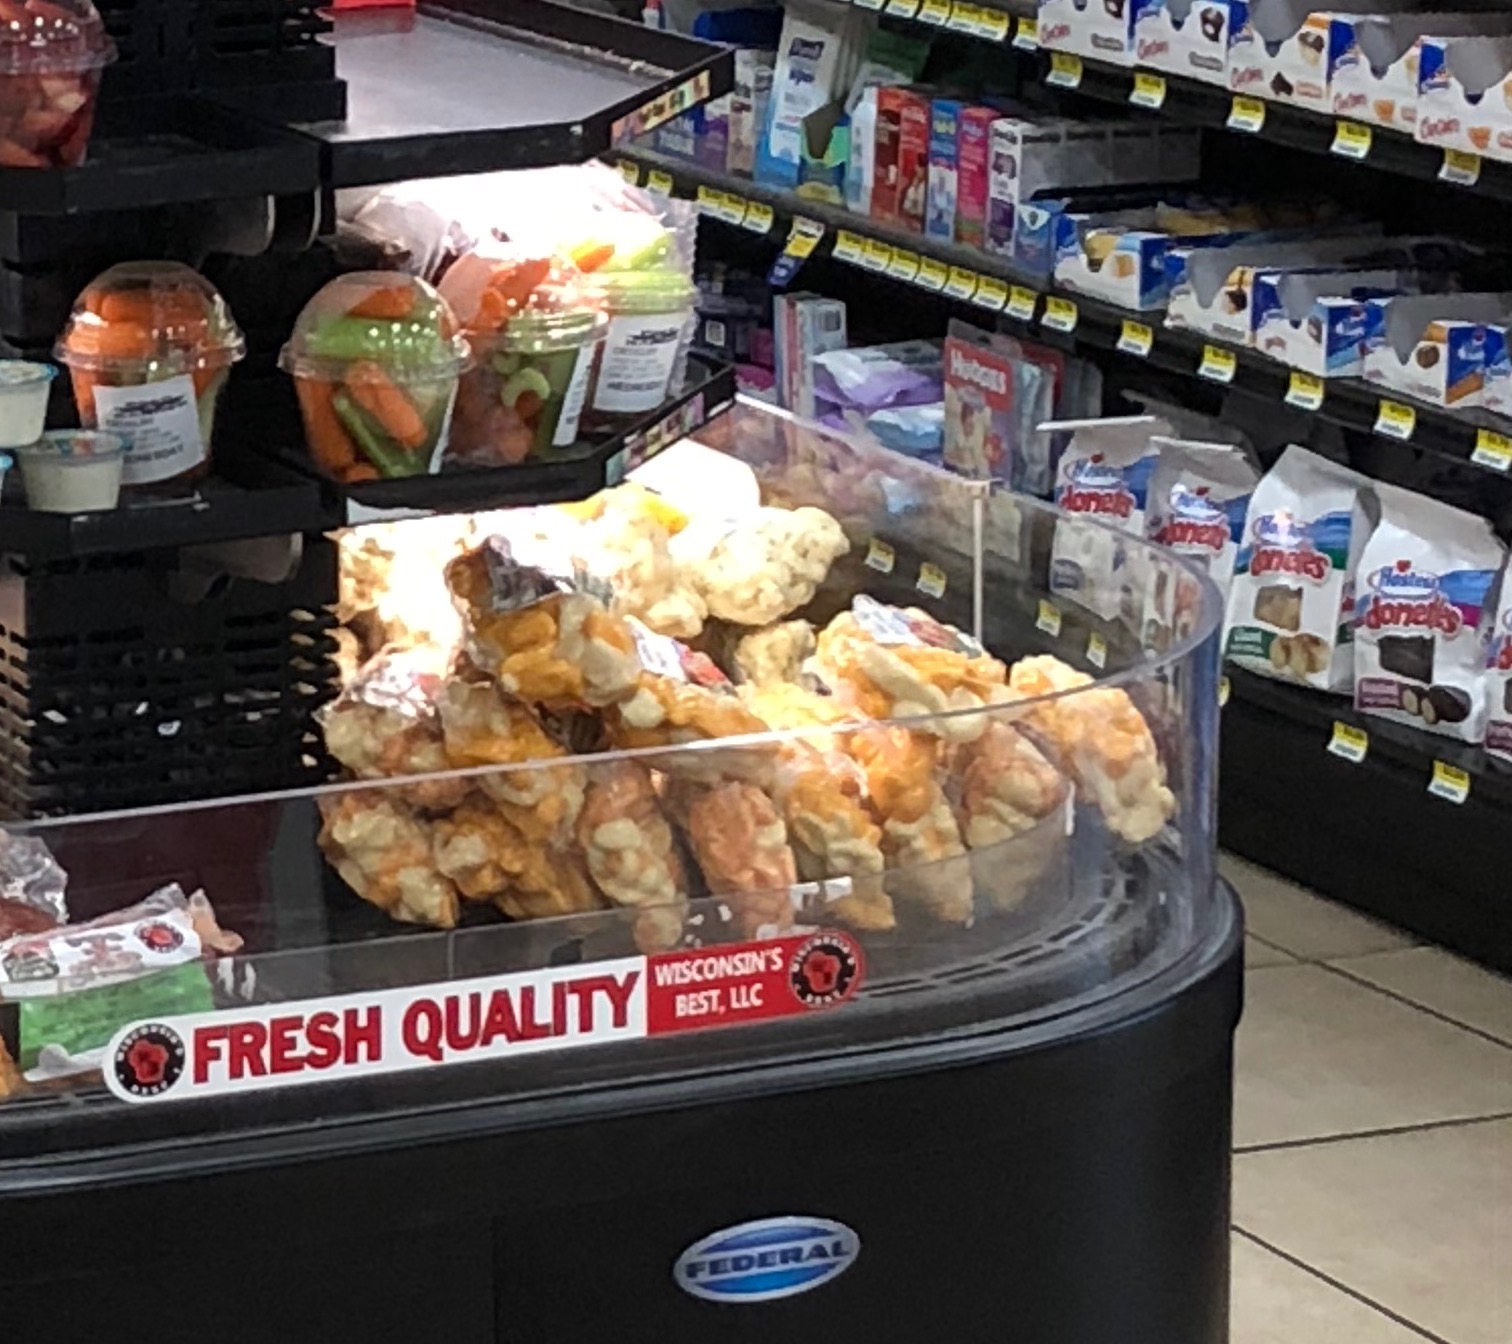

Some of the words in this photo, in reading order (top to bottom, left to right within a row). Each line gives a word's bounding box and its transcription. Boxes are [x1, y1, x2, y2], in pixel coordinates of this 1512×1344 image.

[654, 946, 784, 987] WISCONSIN'S
[675, 989, 726, 1017] BEST,
[729, 983, 764, 1009] LLC
[193, 1004, 381, 1084] FRESH
[402, 971, 640, 1062] QUALITY
[684, 1240, 850, 1279] FEDERAL
